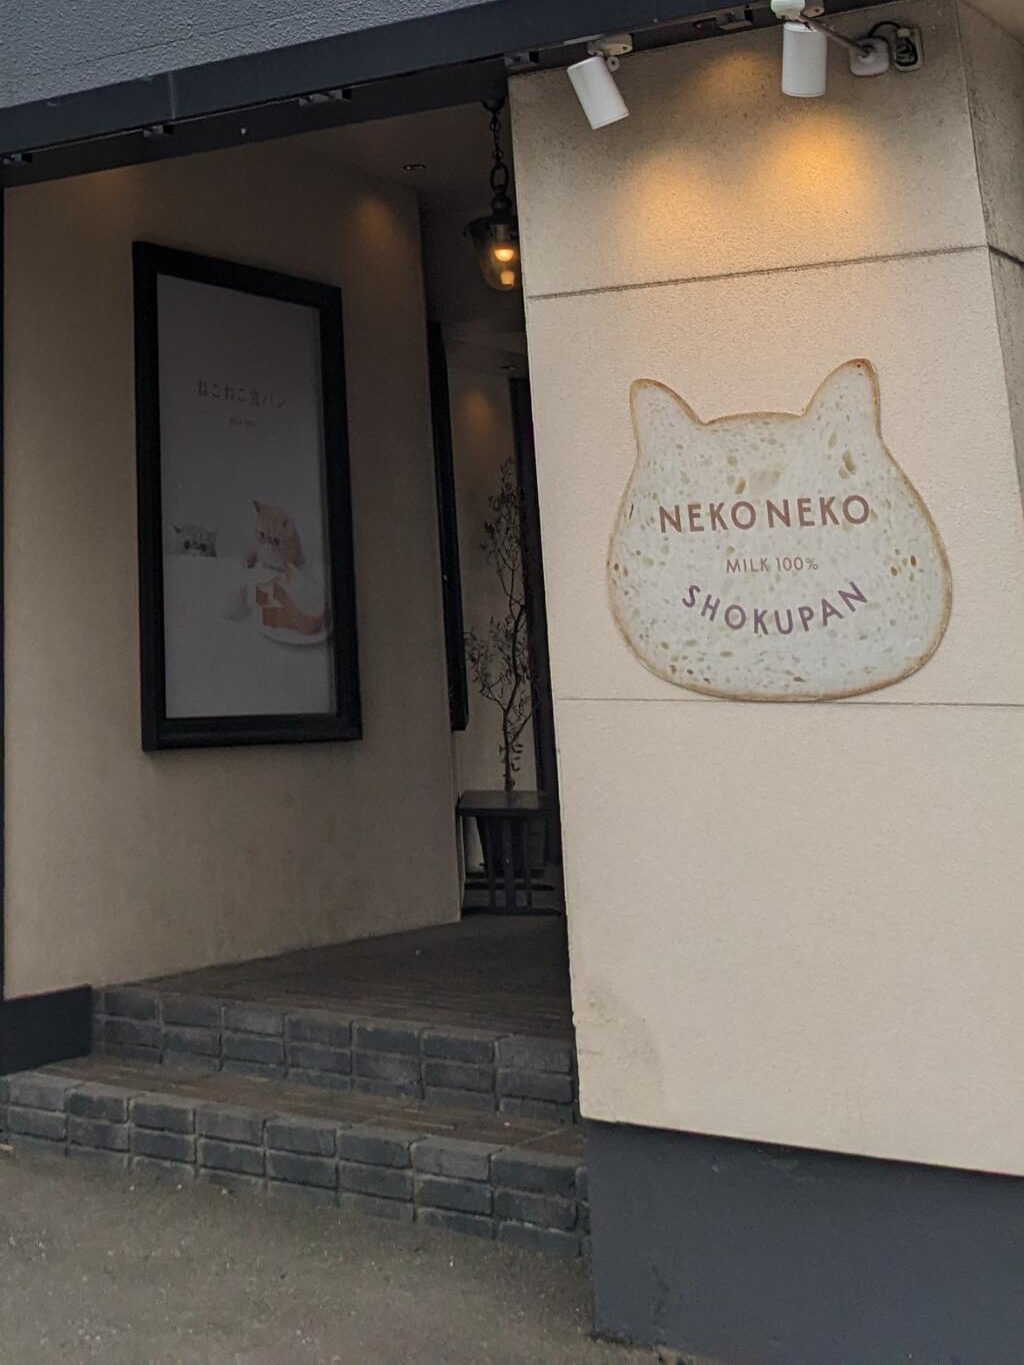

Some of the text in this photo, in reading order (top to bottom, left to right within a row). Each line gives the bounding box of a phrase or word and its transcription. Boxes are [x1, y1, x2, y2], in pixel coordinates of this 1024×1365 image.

[725, 556, 819, 574] MILK 100%
[681, 581, 868, 636] SHOKUPAN
